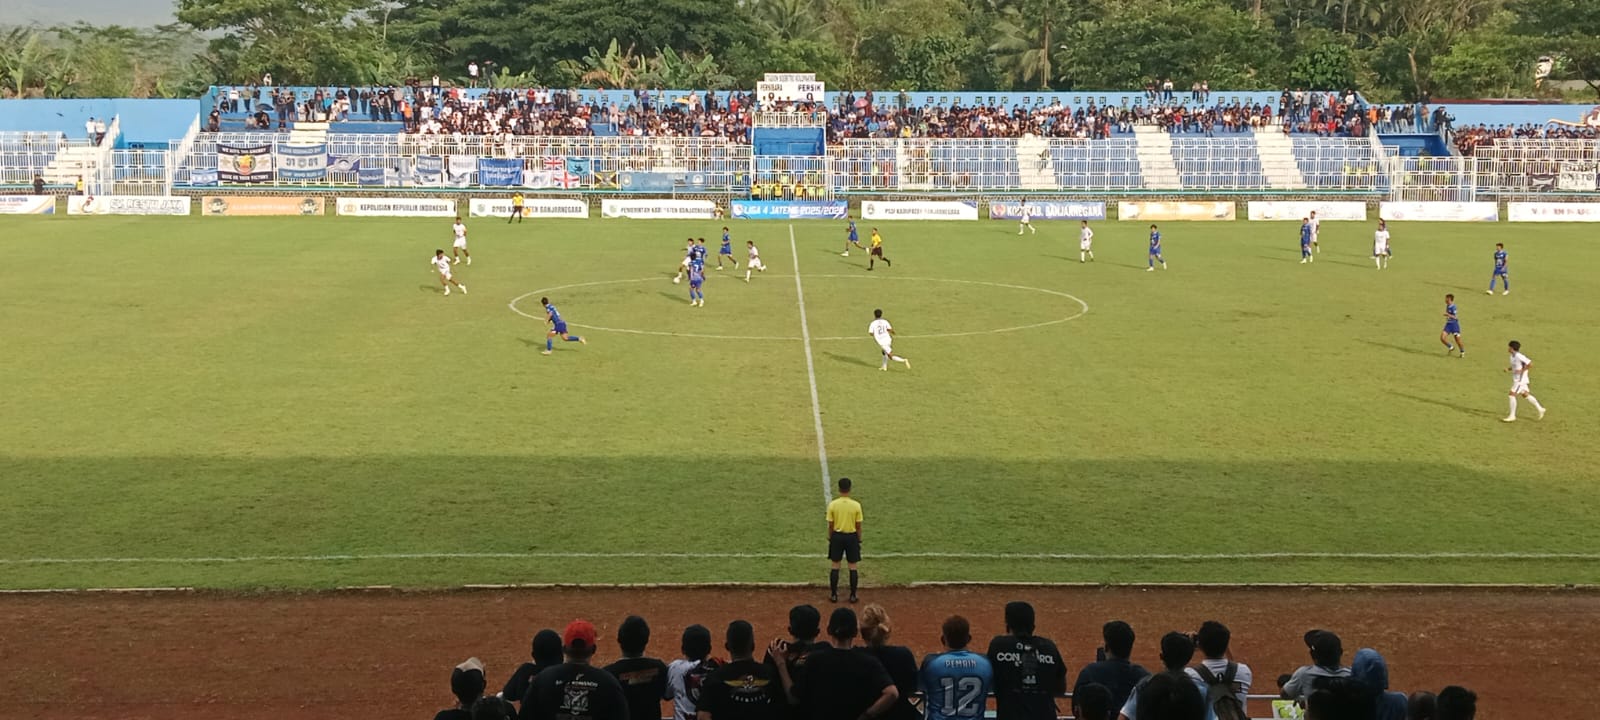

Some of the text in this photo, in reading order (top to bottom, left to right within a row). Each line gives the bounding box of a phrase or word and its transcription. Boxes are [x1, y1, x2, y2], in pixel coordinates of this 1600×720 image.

[798, 84, 821, 92] PERSIK
[126, 199, 160, 210] RESTU
[160, 199, 184, 210] JAYA
[360, 203, 391, 211] KEPOLISIAN
[539, 206, 582, 214] BANJARNEGARA
[743, 205, 762, 215] LIGA
[762, 205, 768, 215] 4
[769, 205, 799, 215] JATENG
[1045, 205, 1103, 217] BANJARNEGARA
[877, 325, 885, 335] 21
[996, 648, 1055, 665] CONROL
[939, 676, 983, 717] 12
